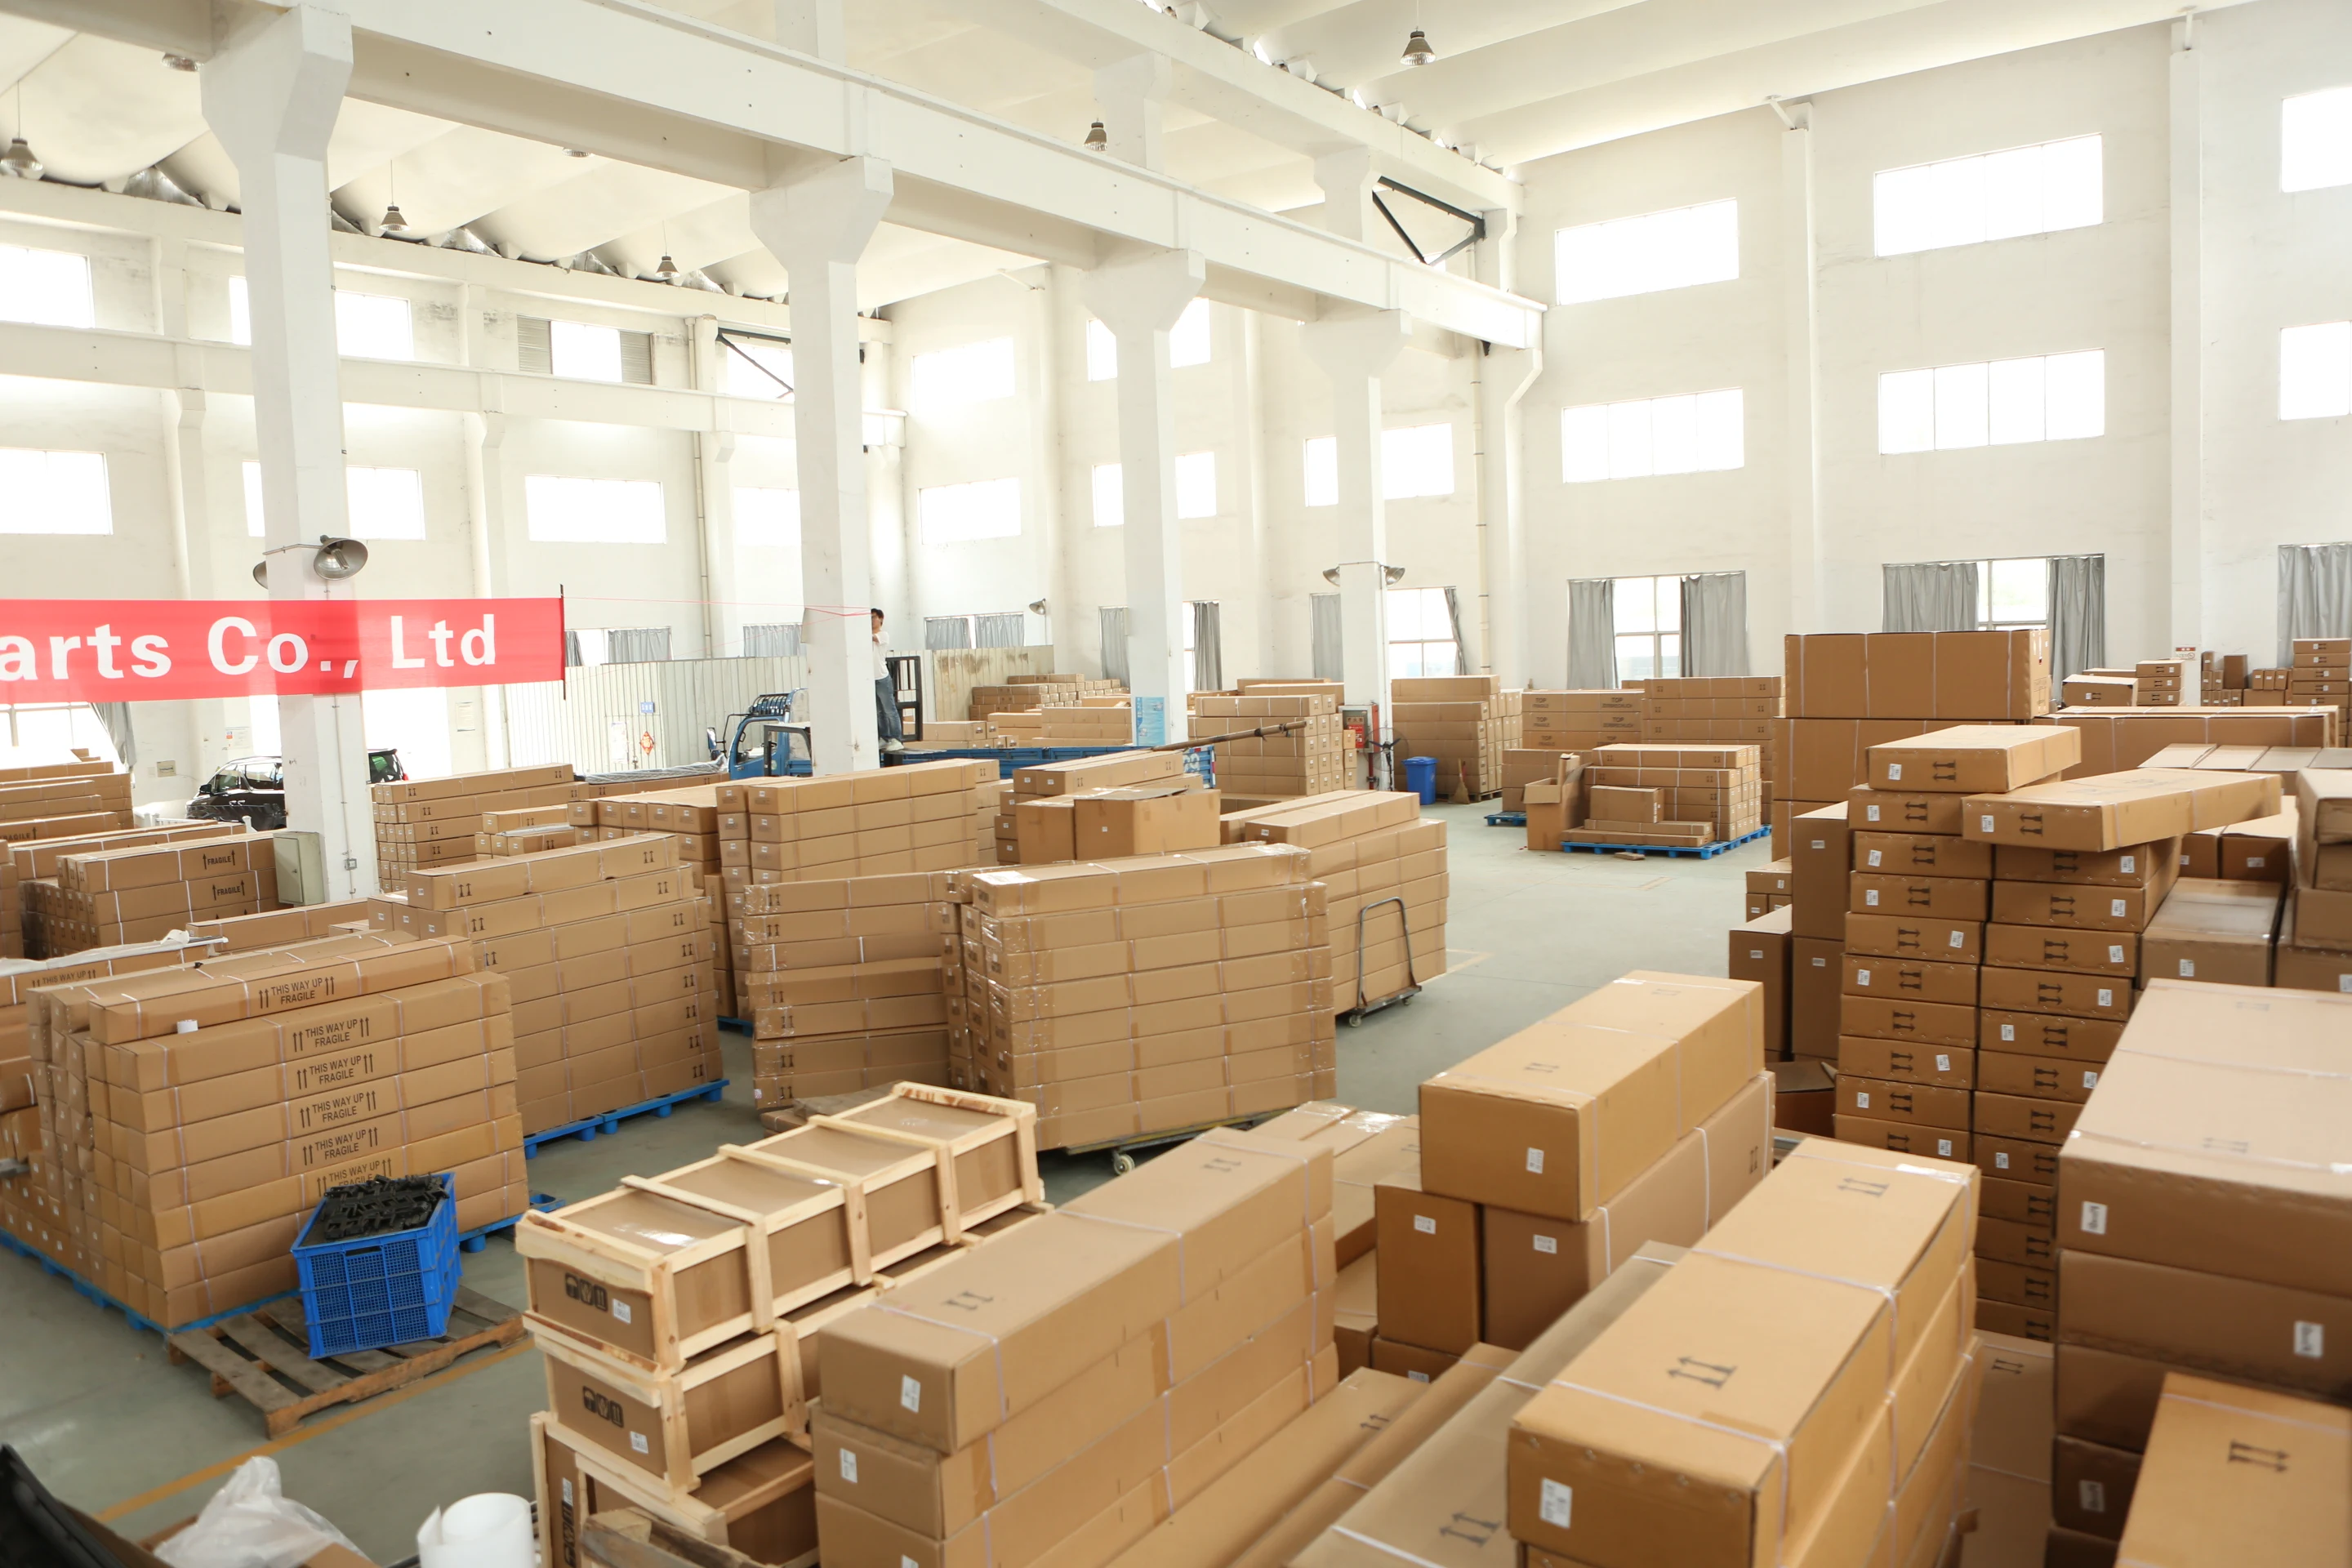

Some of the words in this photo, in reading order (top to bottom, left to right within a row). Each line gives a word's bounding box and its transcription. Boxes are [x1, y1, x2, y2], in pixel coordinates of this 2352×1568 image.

[208, 617, 359, 679] Co.,
[390, 614, 496, 668] Ltd
[207, 856, 232, 865] FRAGILE
[217, 886, 241, 896] FRAGILE
[42, 976, 58, 984] THIS
[59, 973, 75, 982] WAY
[77, 970, 87, 978] UP
[271, 984, 290, 996] THIS
[291, 980, 310, 991] WAY
[312, 978, 323, 987] UP
[280, 990, 315, 1004] FRAGILE
[305, 1026, 323, 1038] THIS
[326, 1022, 345, 1034] WAY
[346, 1018, 358, 1029] UP
[314, 1031, 350, 1047] FRAGILE
[310, 1062, 328, 1075] THIS
[329, 1058, 349, 1070] WAY
[350, 1055, 362, 1066] UP
[319, 1068, 354, 1085] FRAGILE
[312, 1102, 331, 1113] THIS
[332, 1096, 351, 1108] WAY
[354, 1093, 364, 1103] UP
[322, 1106, 358, 1123] FRAGILE
[314, 1139, 334, 1152] THIS
[335, 1133, 354, 1145] WAY
[355, 1129, 367, 1140] UP
[324, 1143, 359, 1160] FRAGILE
[328, 1169, 347, 1182] THIS
[349, 1164, 368, 1176] WAY
[369, 1160, 380, 1170] UP
